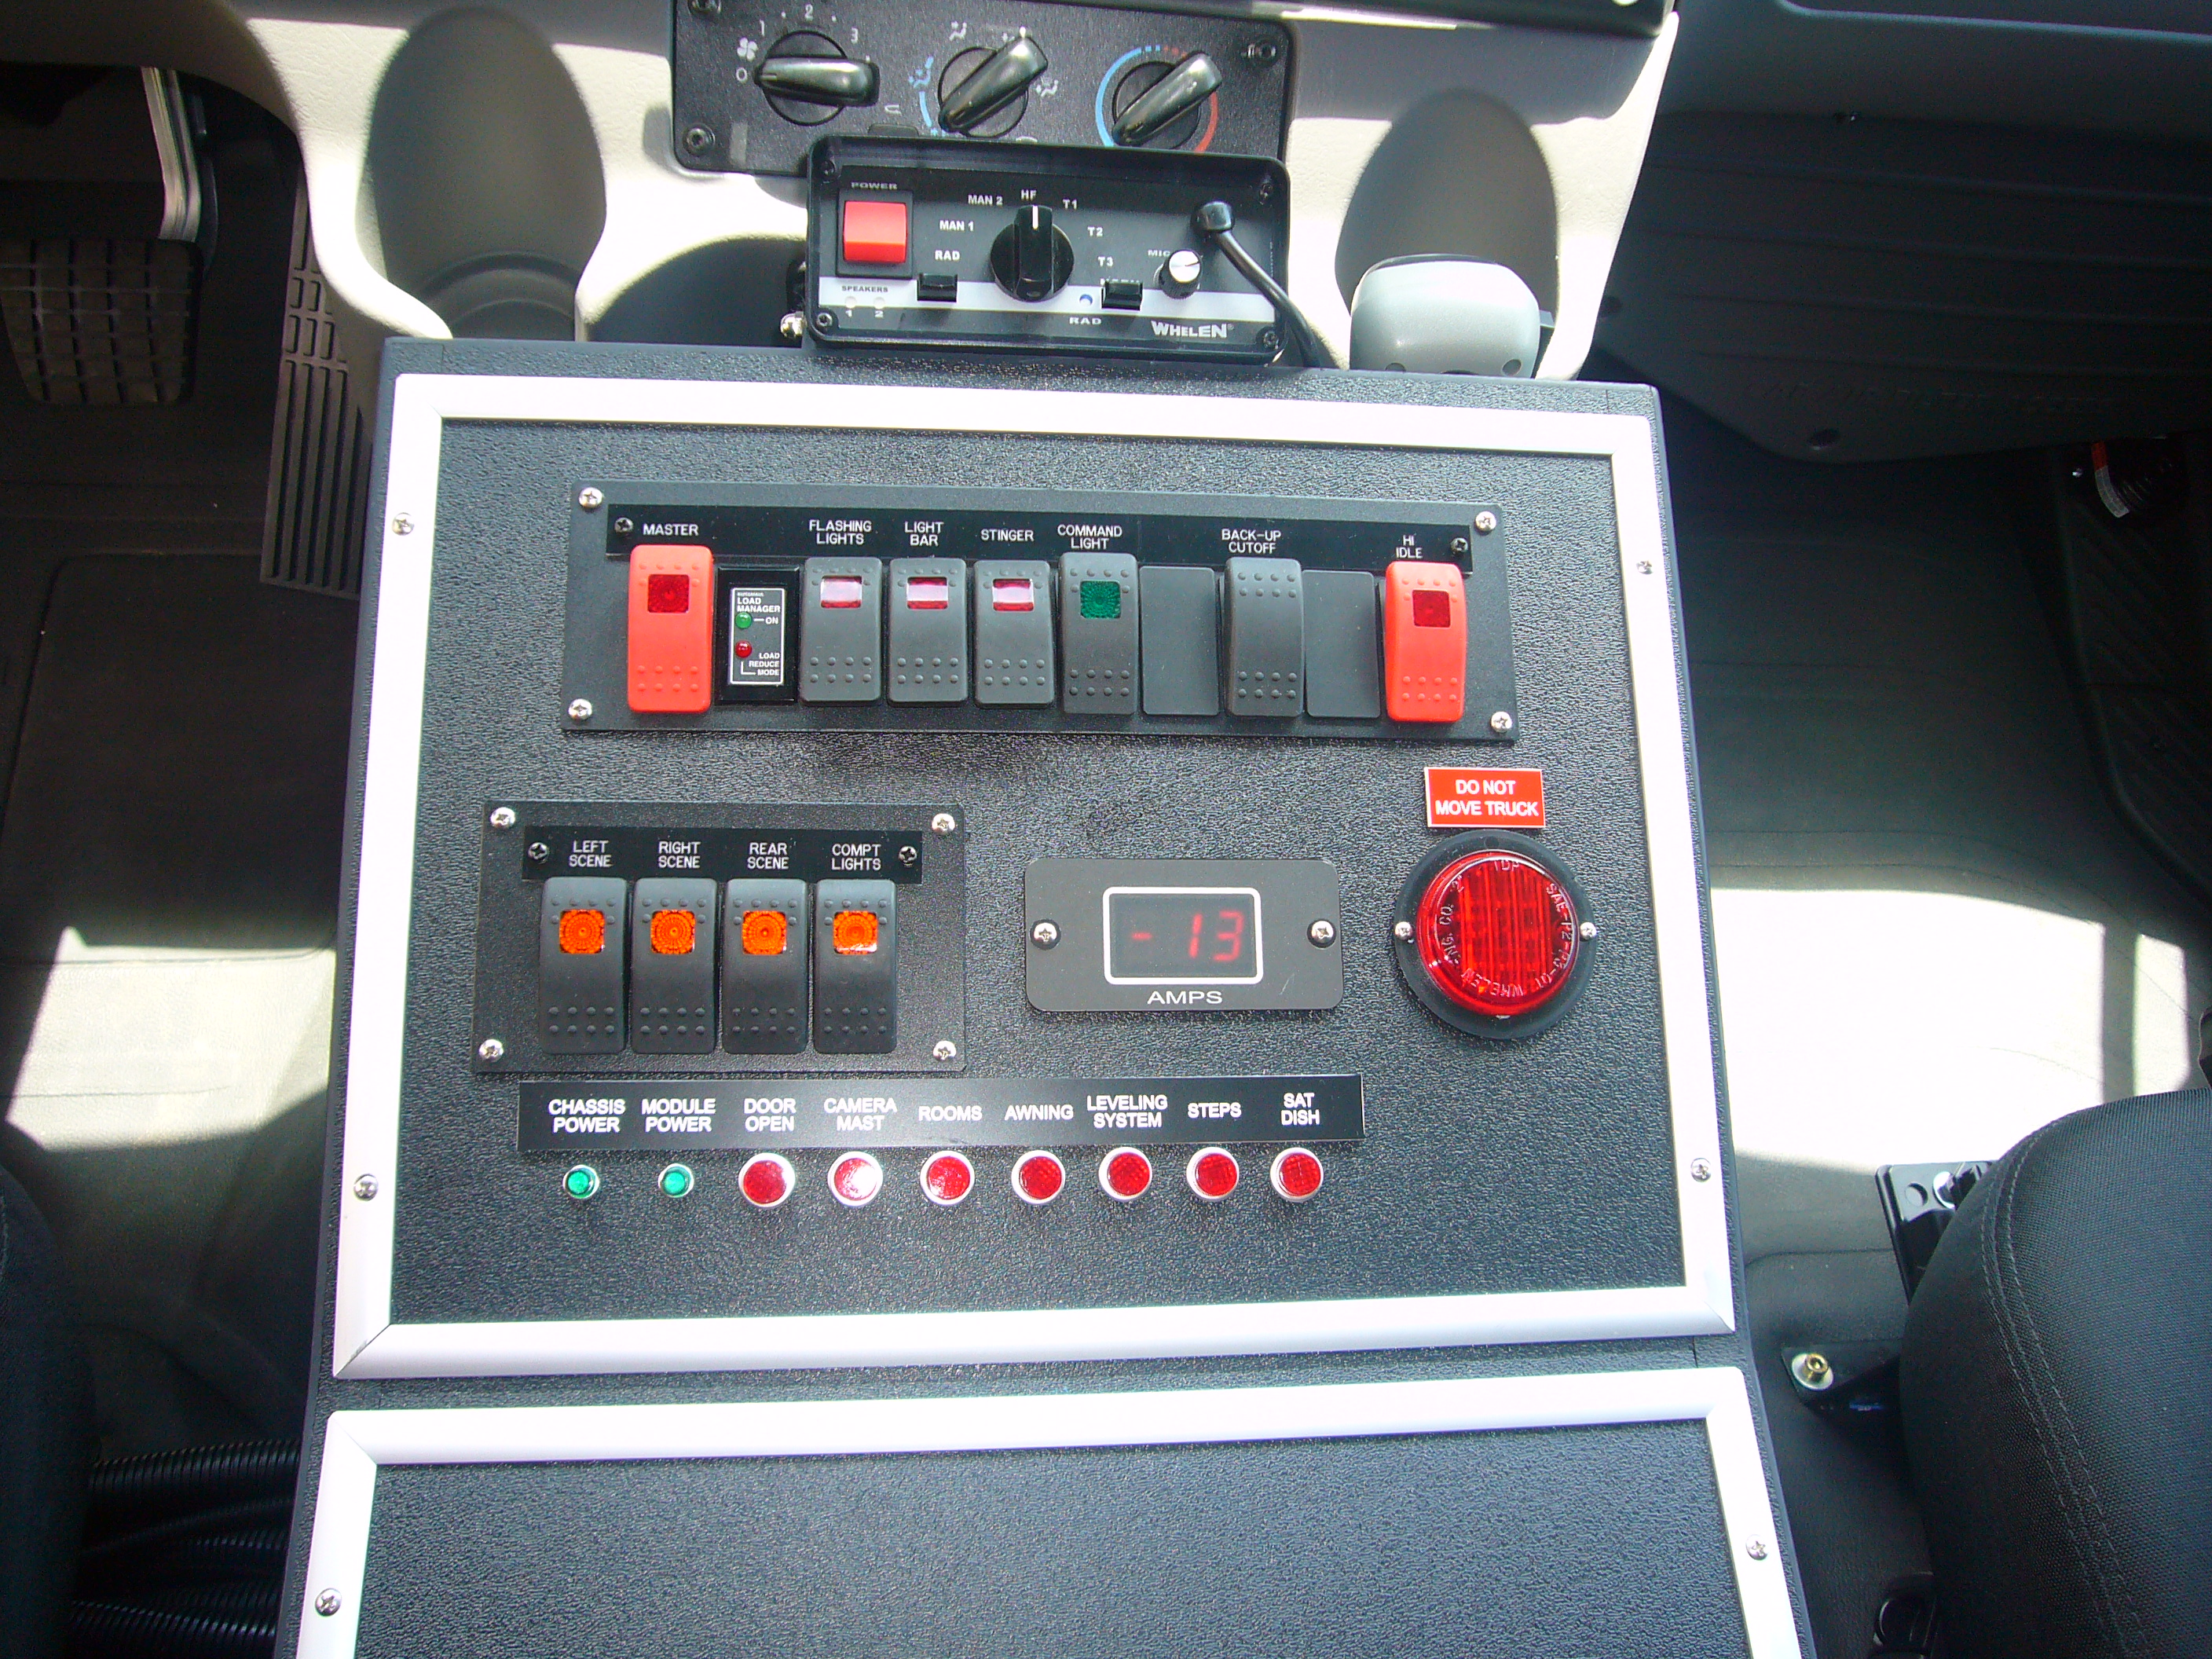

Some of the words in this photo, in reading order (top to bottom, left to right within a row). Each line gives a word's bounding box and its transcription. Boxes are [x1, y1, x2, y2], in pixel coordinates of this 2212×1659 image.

[804, 4, 813, 20] 2
[759, 20, 764, 35] 1
[851, 27, 858, 43] 3
[850, 181, 898, 190] POWER
[968, 194, 993, 205] MAN
[996, 196, 1003, 205] 2
[1020, 189, 1037, 200] HF
[1062, 199, 1077, 209] T1
[939, 220, 965, 230] MAN
[968, 221, 974, 231] 1
[1086, 226, 1103, 236] T2
[934, 250, 961, 260] RAD
[1147, 248, 1171, 257] MIC
[1097, 256, 1113, 266] T3
[841, 284, 888, 293] SPEAKERS
[844, 309, 854, 317] 1
[873, 309, 884, 318] 2
[1068, 316, 1102, 325] RAD
[642, 523, 699, 537] MASTER
[808, 519, 872, 533] FLASHING
[904, 522, 944, 534] LIGHT
[1057, 524, 1122, 538] COMMAND
[815, 533, 865, 545] LIGHTS
[909, 534, 939, 547] BAR
[980, 529, 1035, 543] STINGER
[1221, 528, 1282, 542] BACK-UP
[1402, 535, 1415, 546] HI
[1070, 537, 1111, 550] LIGHT
[1227, 540, 1276, 555] CUTOFF
[1395, 546, 1423, 559] IDLE
[736, 604, 781, 613] MANAGER
[764, 616, 779, 624] ON
[1456, 779, 1478, 793] DO
[1483, 780, 1514, 794] NOT
[1436, 800, 1481, 815] MOVE
[1485, 801, 1537, 815] TRUCK
[573, 840, 608, 853] LEFT
[658, 841, 700, 855] RIGHT
[749, 842, 786, 856] REAR
[832, 844, 881, 856] COMPT
[569, 854, 610, 867] SCENE
[658, 855, 700, 868] SCENE
[747, 856, 788, 869] SCENE
[831, 858, 881, 870] LIGHTS
[1145, 990, 1224, 1005] AMPS
[548, 1098, 626, 1116] CHASSIS
[641, 1097, 716, 1115] MODULE
[743, 1097, 797, 1115] DOOR
[823, 1097, 898, 1115] CAMERA
[1086, 1094, 1168, 1111] LEVELING
[1284, 1092, 1316, 1110] SAT
[917, 1105, 983, 1122] ROOMS
[1004, 1104, 1075, 1122] AWNING
[1187, 1101, 1243, 1119] STEPS
[1280, 1108, 1320, 1126] DISH
[552, 1116, 621, 1133] POWER
[645, 1115, 712, 1133] POWER
[745, 1115, 796, 1132] OPEN
[836, 1114, 885, 1131] MAST
[1093, 1111, 1163, 1129] SYSTEM
